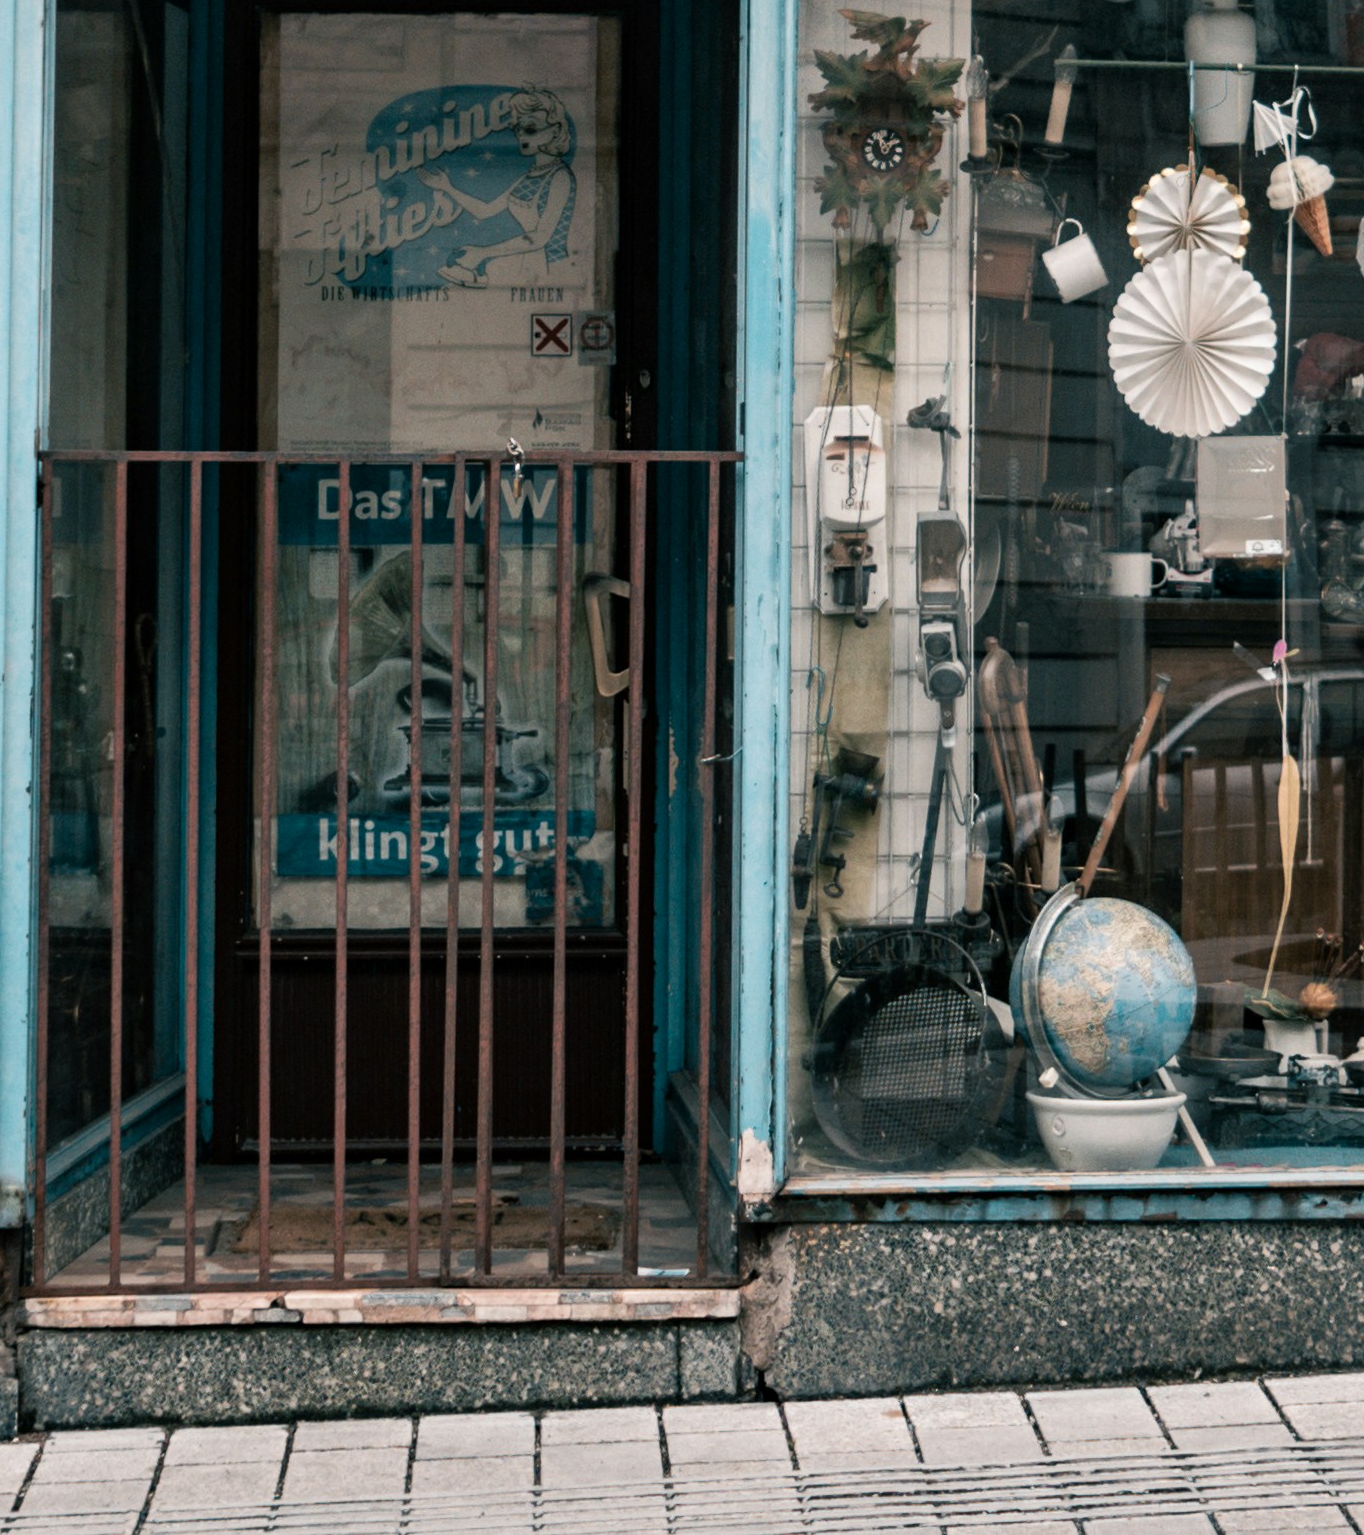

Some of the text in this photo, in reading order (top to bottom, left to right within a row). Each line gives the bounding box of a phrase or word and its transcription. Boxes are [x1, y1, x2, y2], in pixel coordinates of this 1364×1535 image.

[290, 90, 514, 216] Feminine
[292, 189, 464, 286] Fifties
[321, 286, 345, 302] DIE
[510, 287, 565, 303] FRAUEN
[318, 478, 556, 520] Das TMW
[319, 818, 556, 873] klingt gut
